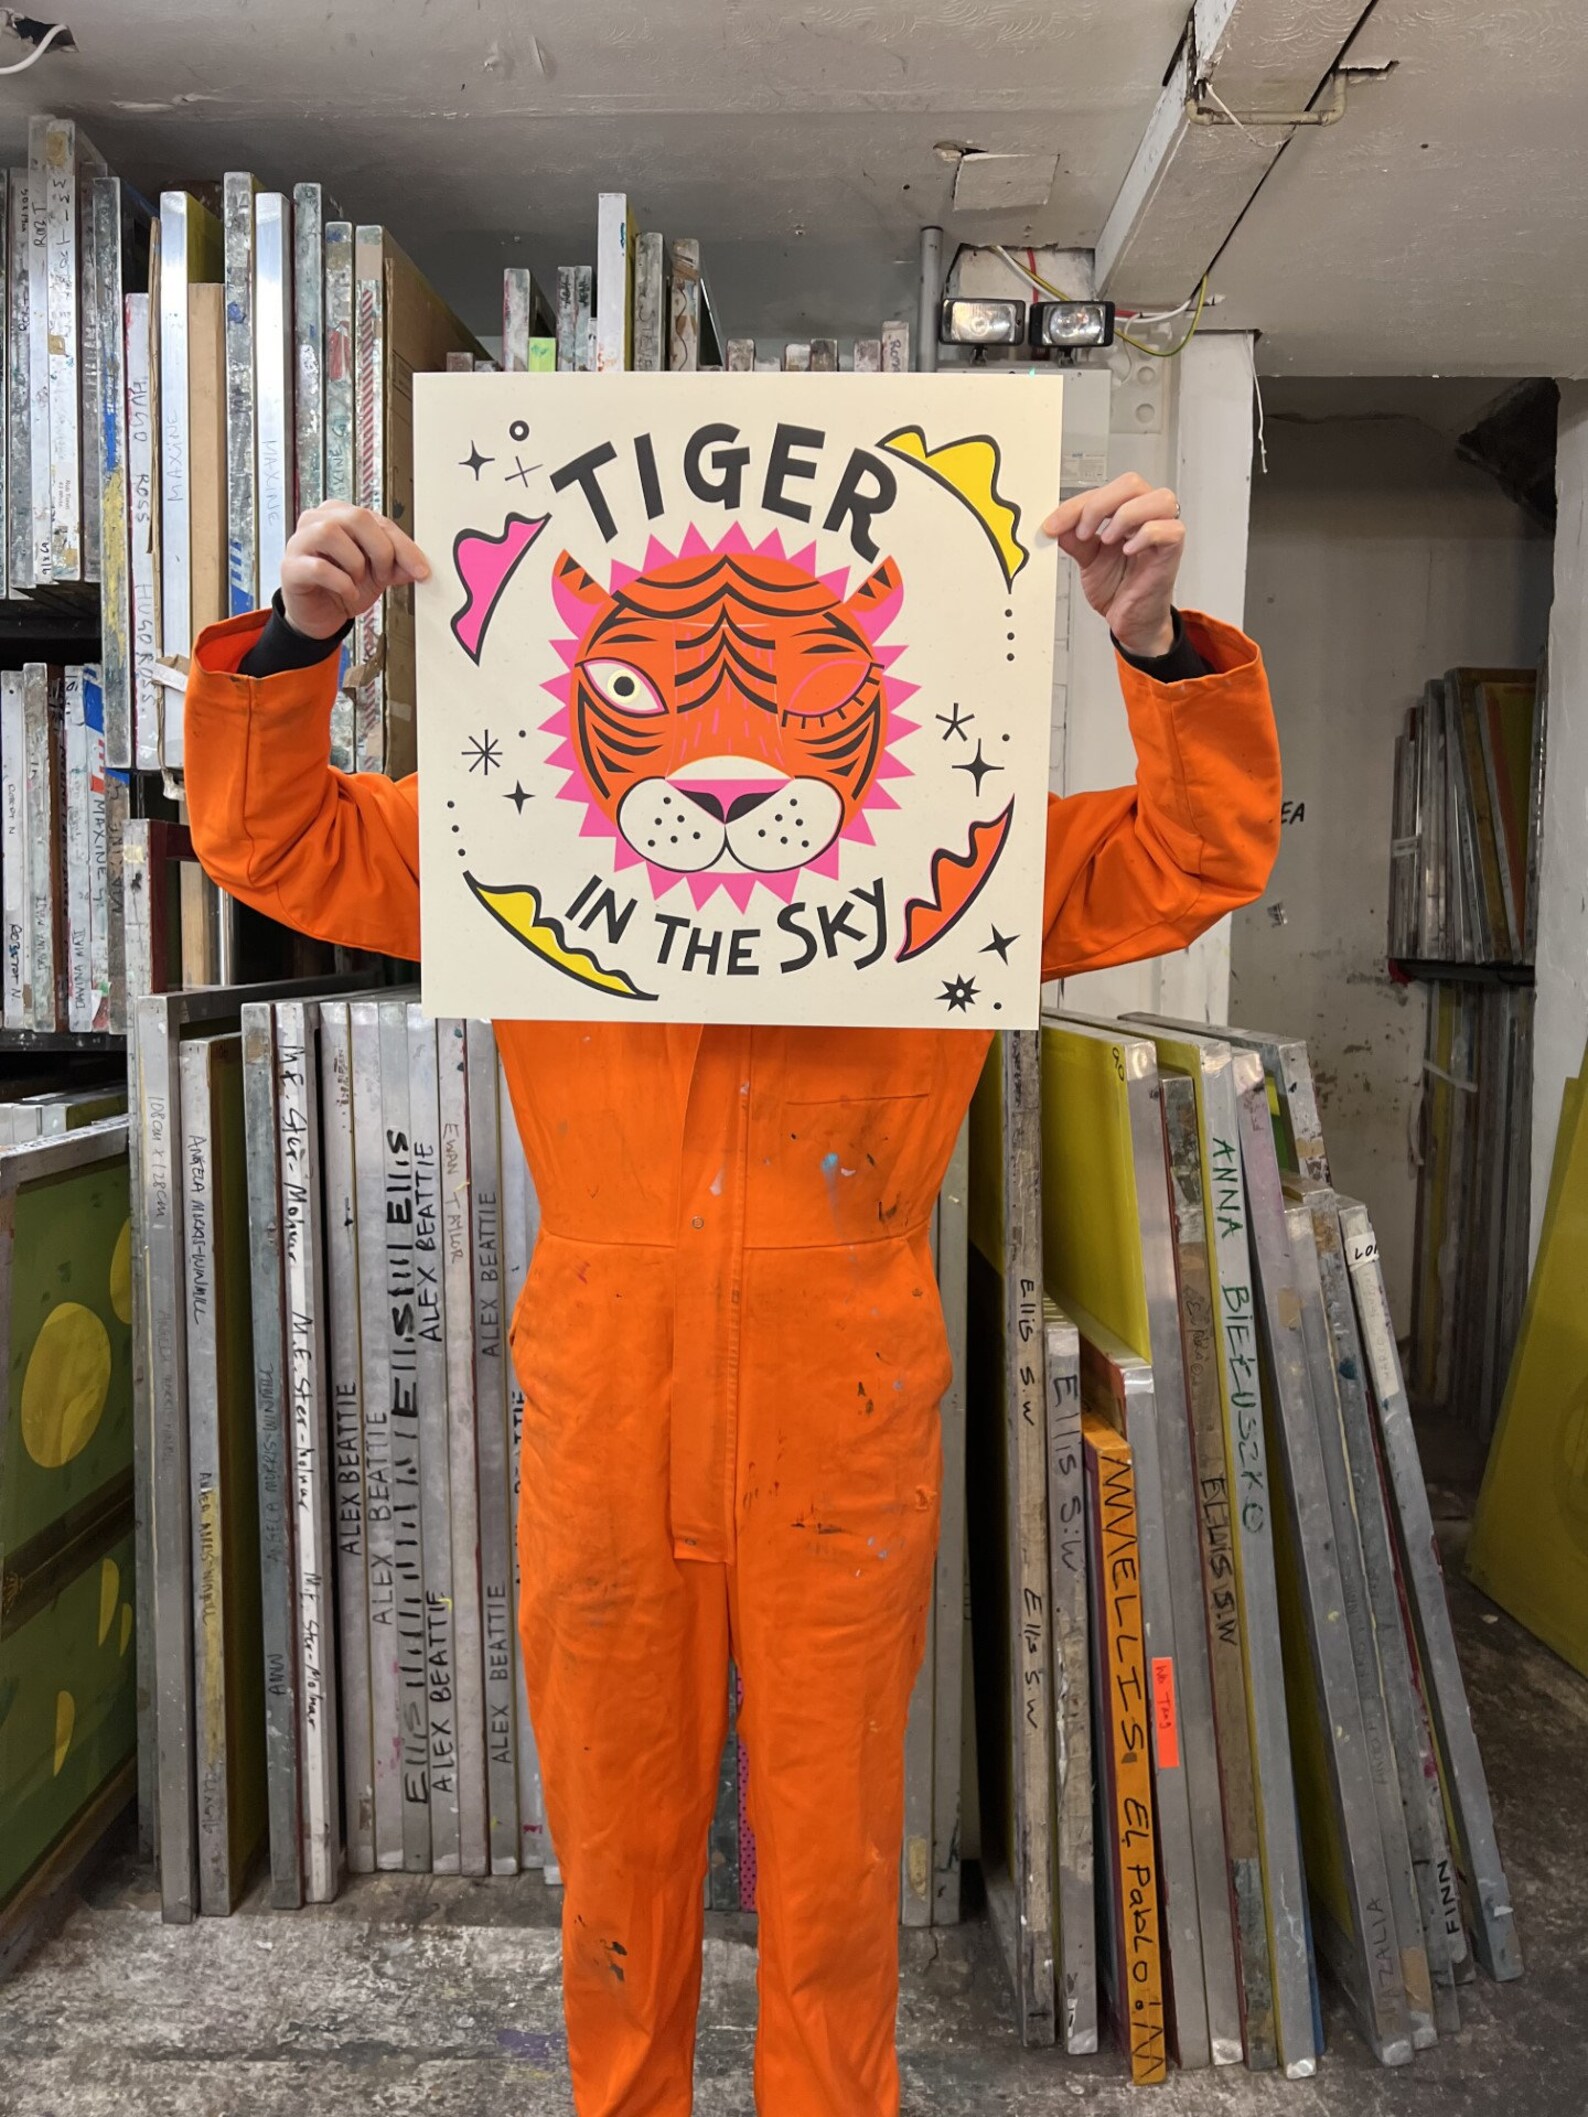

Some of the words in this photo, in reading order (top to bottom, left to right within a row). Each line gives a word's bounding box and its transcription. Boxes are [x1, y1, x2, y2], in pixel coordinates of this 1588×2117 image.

[131, 381, 149, 444] HUGO
[135, 473, 150, 523] ROSS
[549, 422, 897, 564] TIGER
[134, 584, 152, 646] HUGO
[92, 799, 107, 881] MAXINE
[564, 874, 638, 945] IN
[653, 911, 761, 976] THE
[775, 877, 887, 976] SKY
[443, 1123, 461, 1175] EWAN
[413, 1141, 438, 1252] BEATTIE
[1213, 1137, 1244, 1240] ANNA
[444, 1191, 468, 1265] TAYLOR
[477, 1191, 499, 1283] BEATTIE
[415, 1265, 443, 1343] ALEX
[479, 1297, 500, 1358] ALEX
[1019, 1278, 1036, 1343] Ellis
[334, 1380, 361, 1485] BEATTIE
[1052, 1374, 1079, 1476] Ellis
[365, 1410, 391, 1522] BEATTIE
[338, 1492, 364, 1557] ALEX
[373, 1553, 394, 1627] ALEX
[426, 1589, 453, 1704] BEATTIE
[487, 1584, 509, 1682] BEATTIE
[431, 1717, 454, 1795] ALEX
[492, 1703, 513, 1764] ALEX
[1436, 1859, 1461, 1936] FINN
